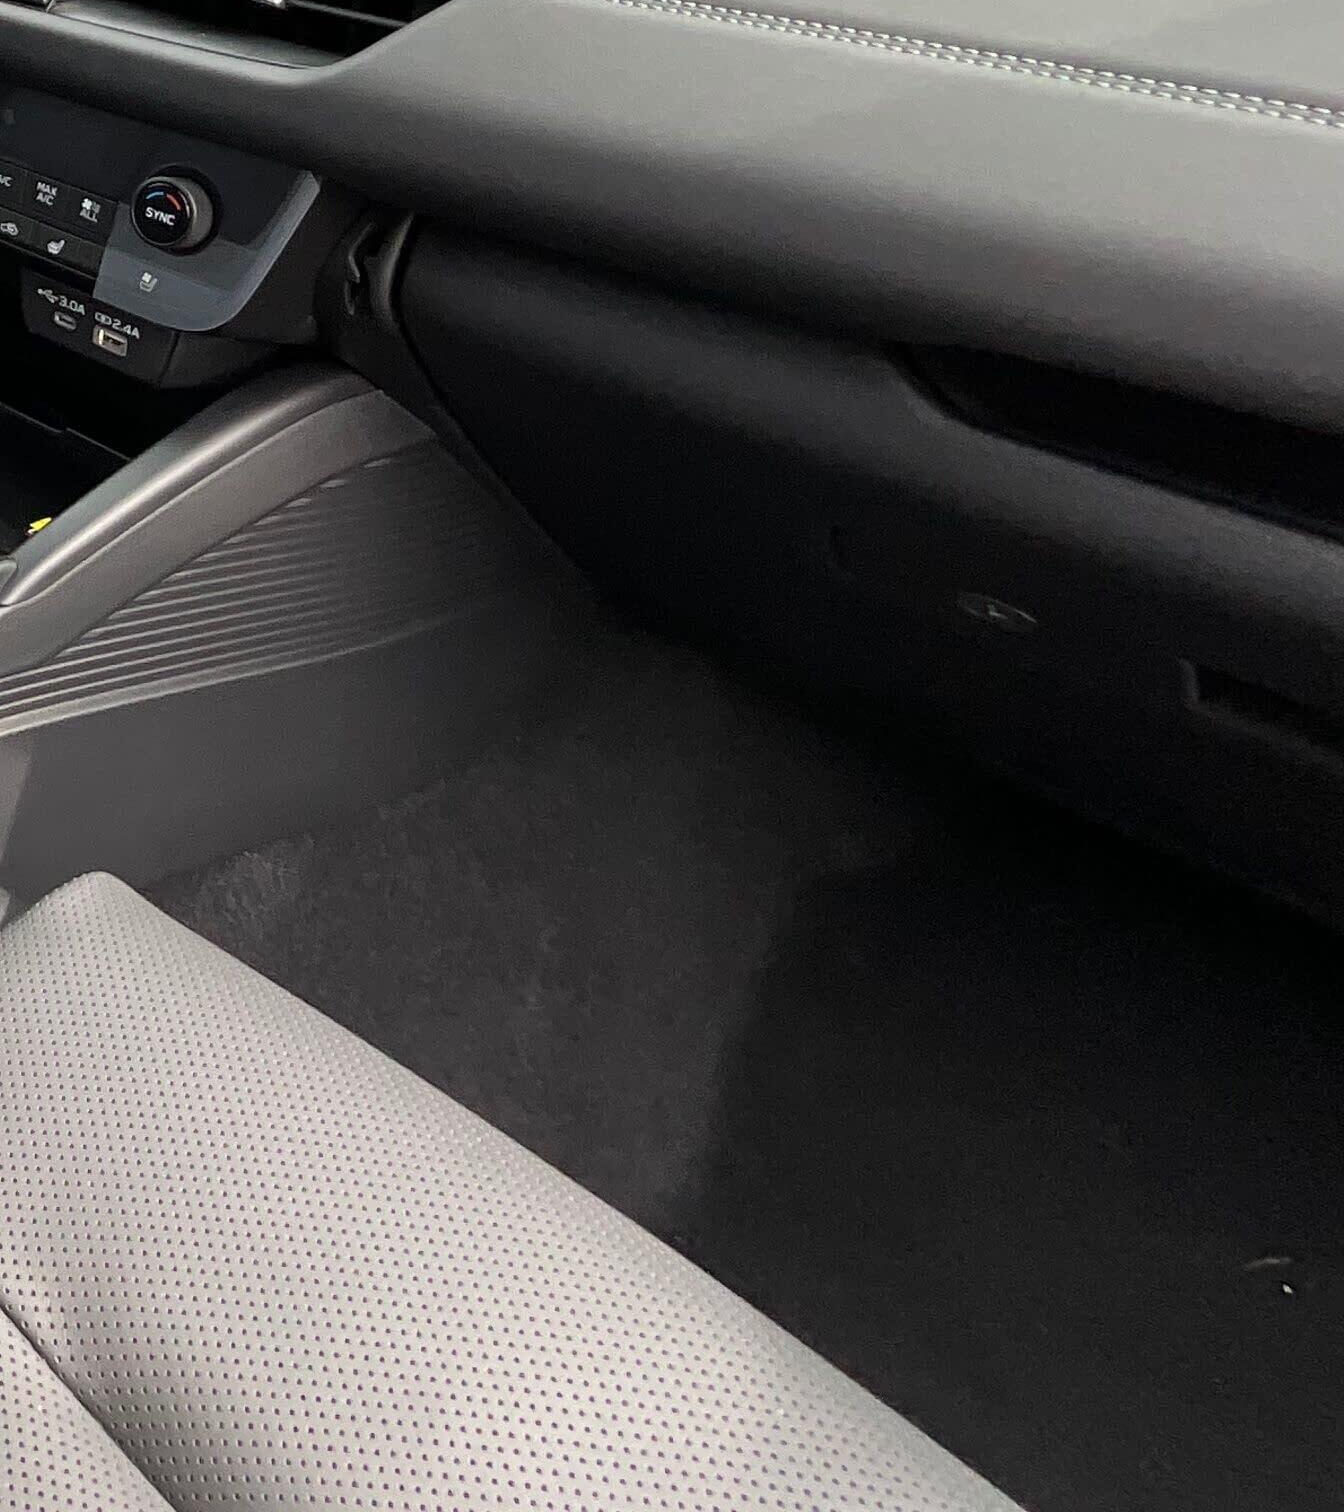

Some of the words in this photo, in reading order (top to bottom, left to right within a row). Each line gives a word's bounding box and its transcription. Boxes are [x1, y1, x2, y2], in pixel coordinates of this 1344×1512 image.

[36, 181, 58, 196] MAX
[36, 192, 55, 206] A/C
[79, 207, 99, 223] ALL
[145, 206, 176, 226] SYNC
[58, 295, 86, 316] 3.0A
[112, 318, 140, 339] 2.4A
